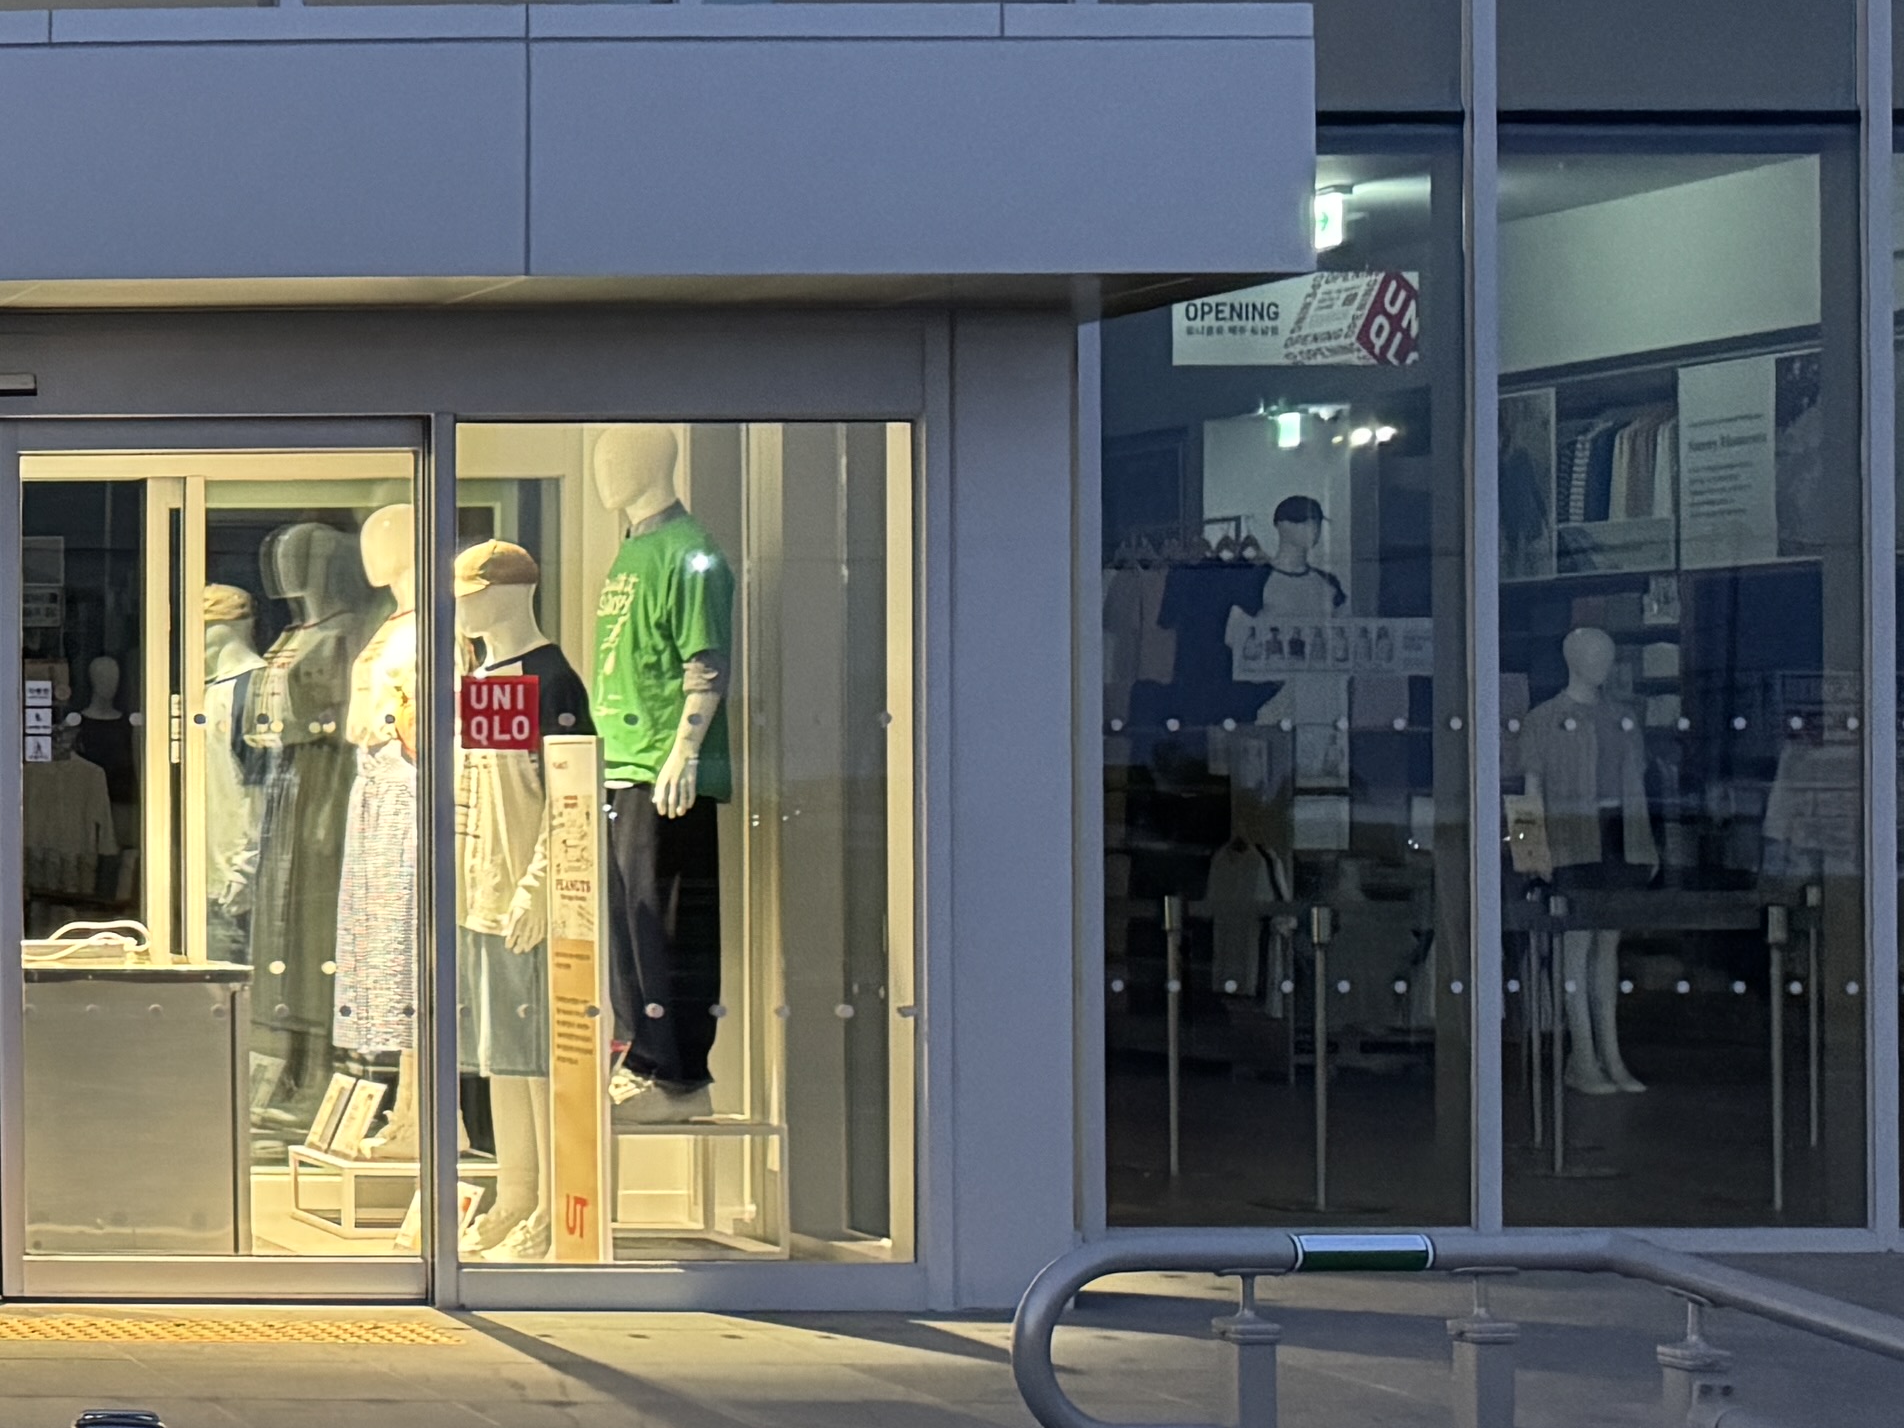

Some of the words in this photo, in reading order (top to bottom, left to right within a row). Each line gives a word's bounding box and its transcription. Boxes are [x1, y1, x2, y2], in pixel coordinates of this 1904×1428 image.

[1184, 301, 1280, 322] OPENING
[470, 684, 524, 710] UNI
[470, 715, 530, 746] QLO
[565, 1193, 588, 1239] UT
